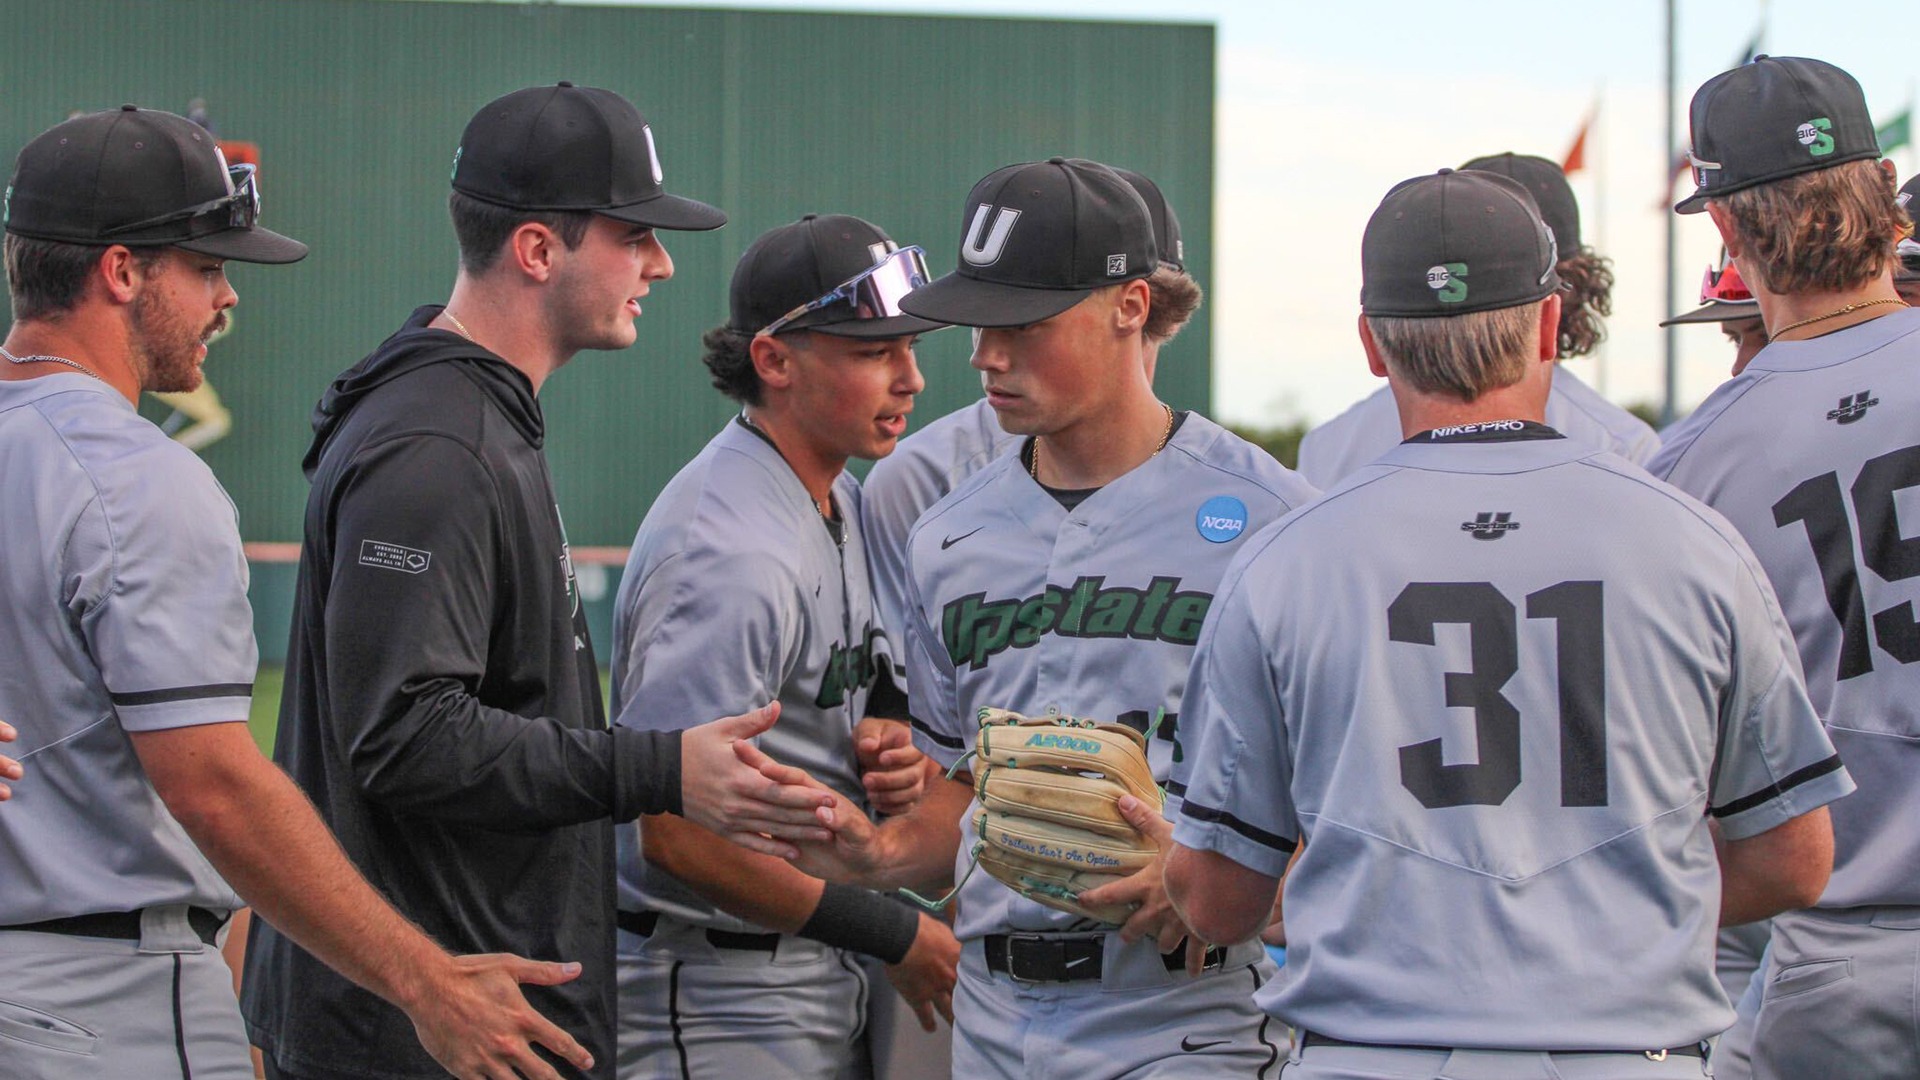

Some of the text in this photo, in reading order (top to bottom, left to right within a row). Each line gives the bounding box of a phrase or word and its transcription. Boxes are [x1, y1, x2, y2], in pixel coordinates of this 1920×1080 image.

[1796, 127, 1818, 139] BIG
[962, 203, 1023, 267] U
[1426, 272, 1449, 282] BIG
[1431, 419, 1525, 439] NIKE PRO
[1201, 515, 1243, 531] NCAA
[362, 555, 382, 563] ALWAYS
[941, 575, 1215, 672] Upstate
[1387, 579, 1609, 810] 31
[1025, 733, 1102, 755] A2000
[1065, 849, 1084, 862] An
[1086, 851, 1121, 867] Option
